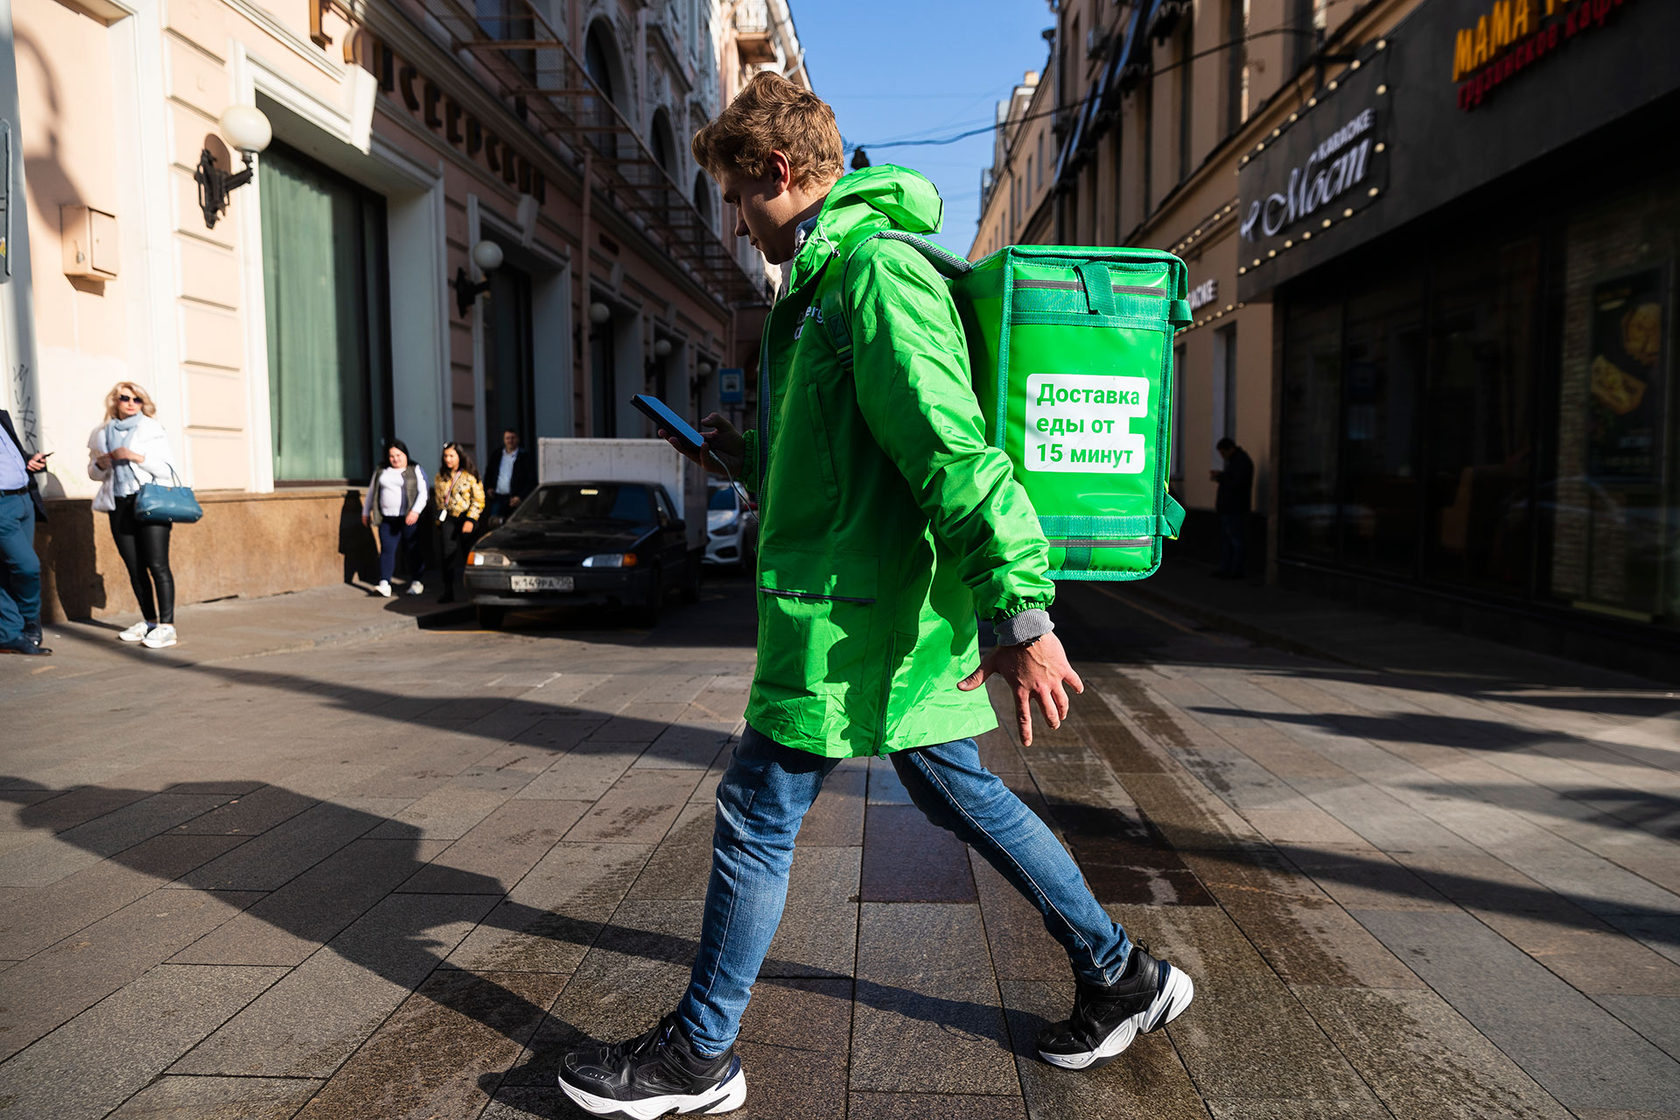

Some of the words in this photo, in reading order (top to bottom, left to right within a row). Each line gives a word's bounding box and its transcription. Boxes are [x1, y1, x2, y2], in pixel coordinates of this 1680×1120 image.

[1565, 0, 1624, 38] каф
[1453, 0, 1530, 83] МАМА
[1036, 383, 1140, 406] Доставка
[1036, 417, 1084, 436] еды
[1091, 419, 1115, 434] от
[1036, 443, 1063, 462] 15
[1070, 448, 1133, 468] минут
